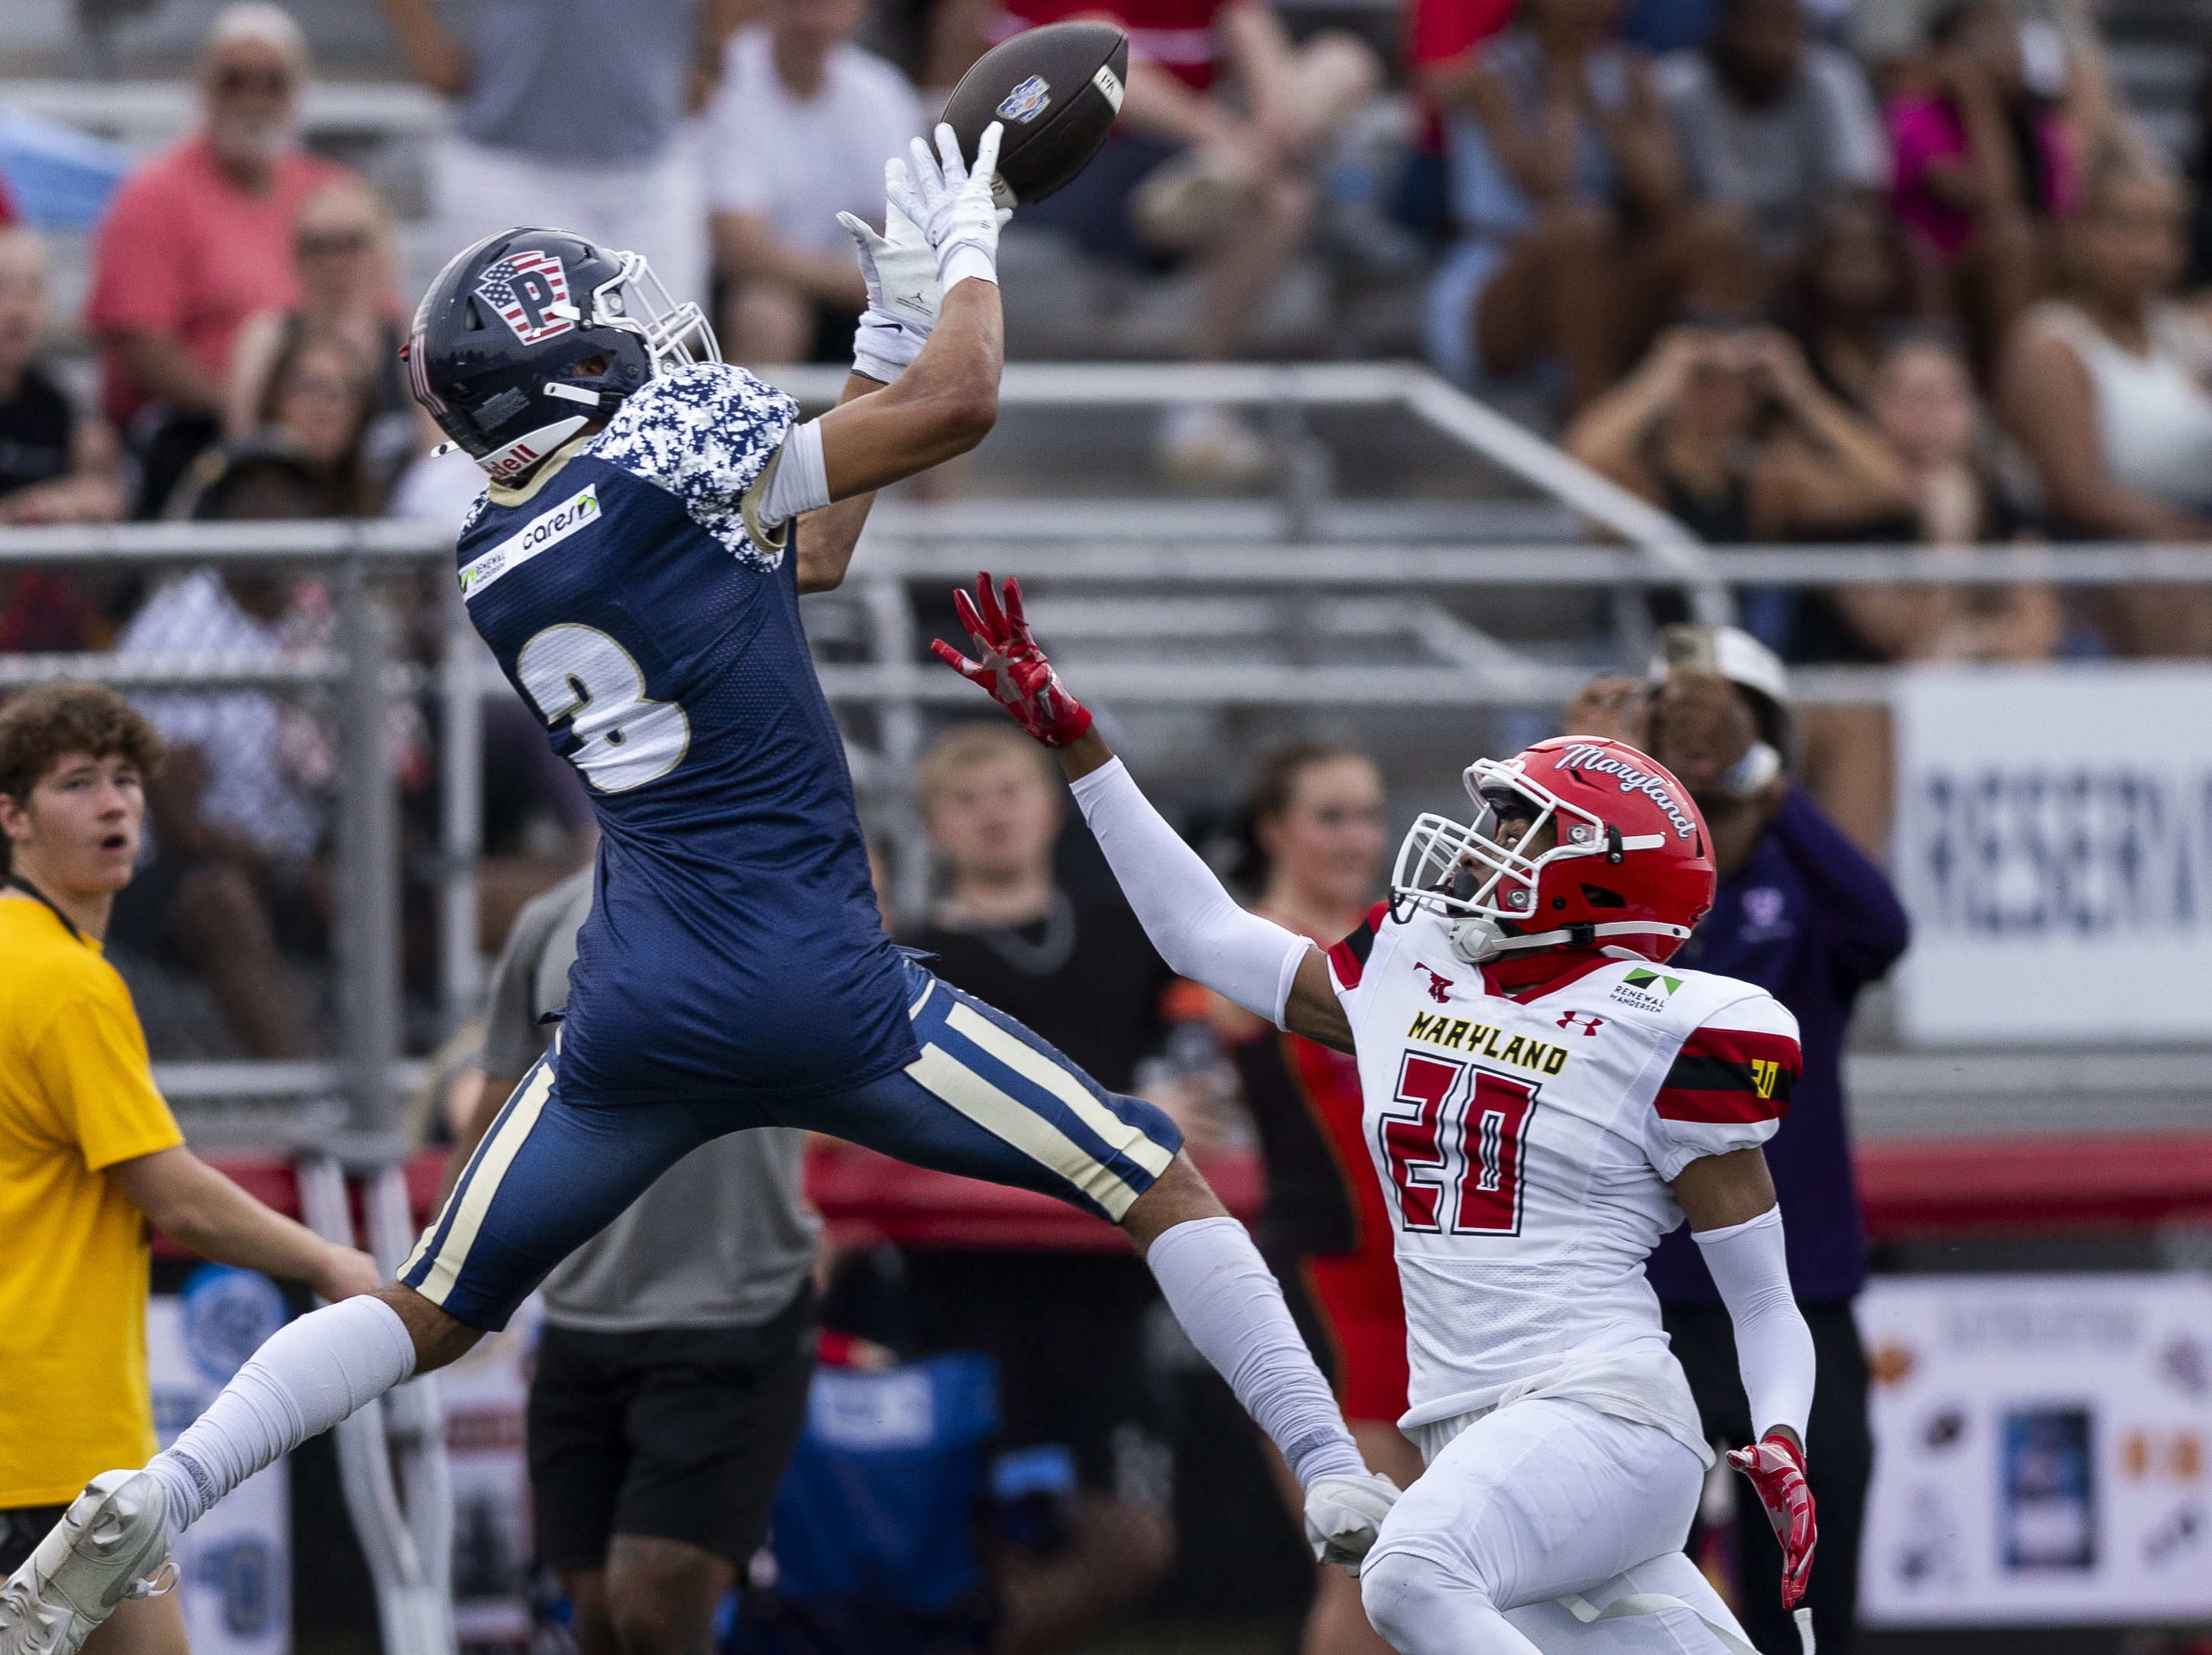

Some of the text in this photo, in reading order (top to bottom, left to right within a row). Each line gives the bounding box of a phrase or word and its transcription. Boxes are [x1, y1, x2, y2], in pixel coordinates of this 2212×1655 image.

[505, 270, 555, 331] P
[523, 506, 575, 551] cares
[516, 622, 692, 794] 3
[1553, 742, 1697, 839] Maryland
[1613, 985, 1665, 1008] RENEWAL
[1616, 997, 1663, 1013] ANDERSEN
[1406, 1010, 1569, 1076] MARYLAND
[1377, 1048, 1543, 1238] 20
